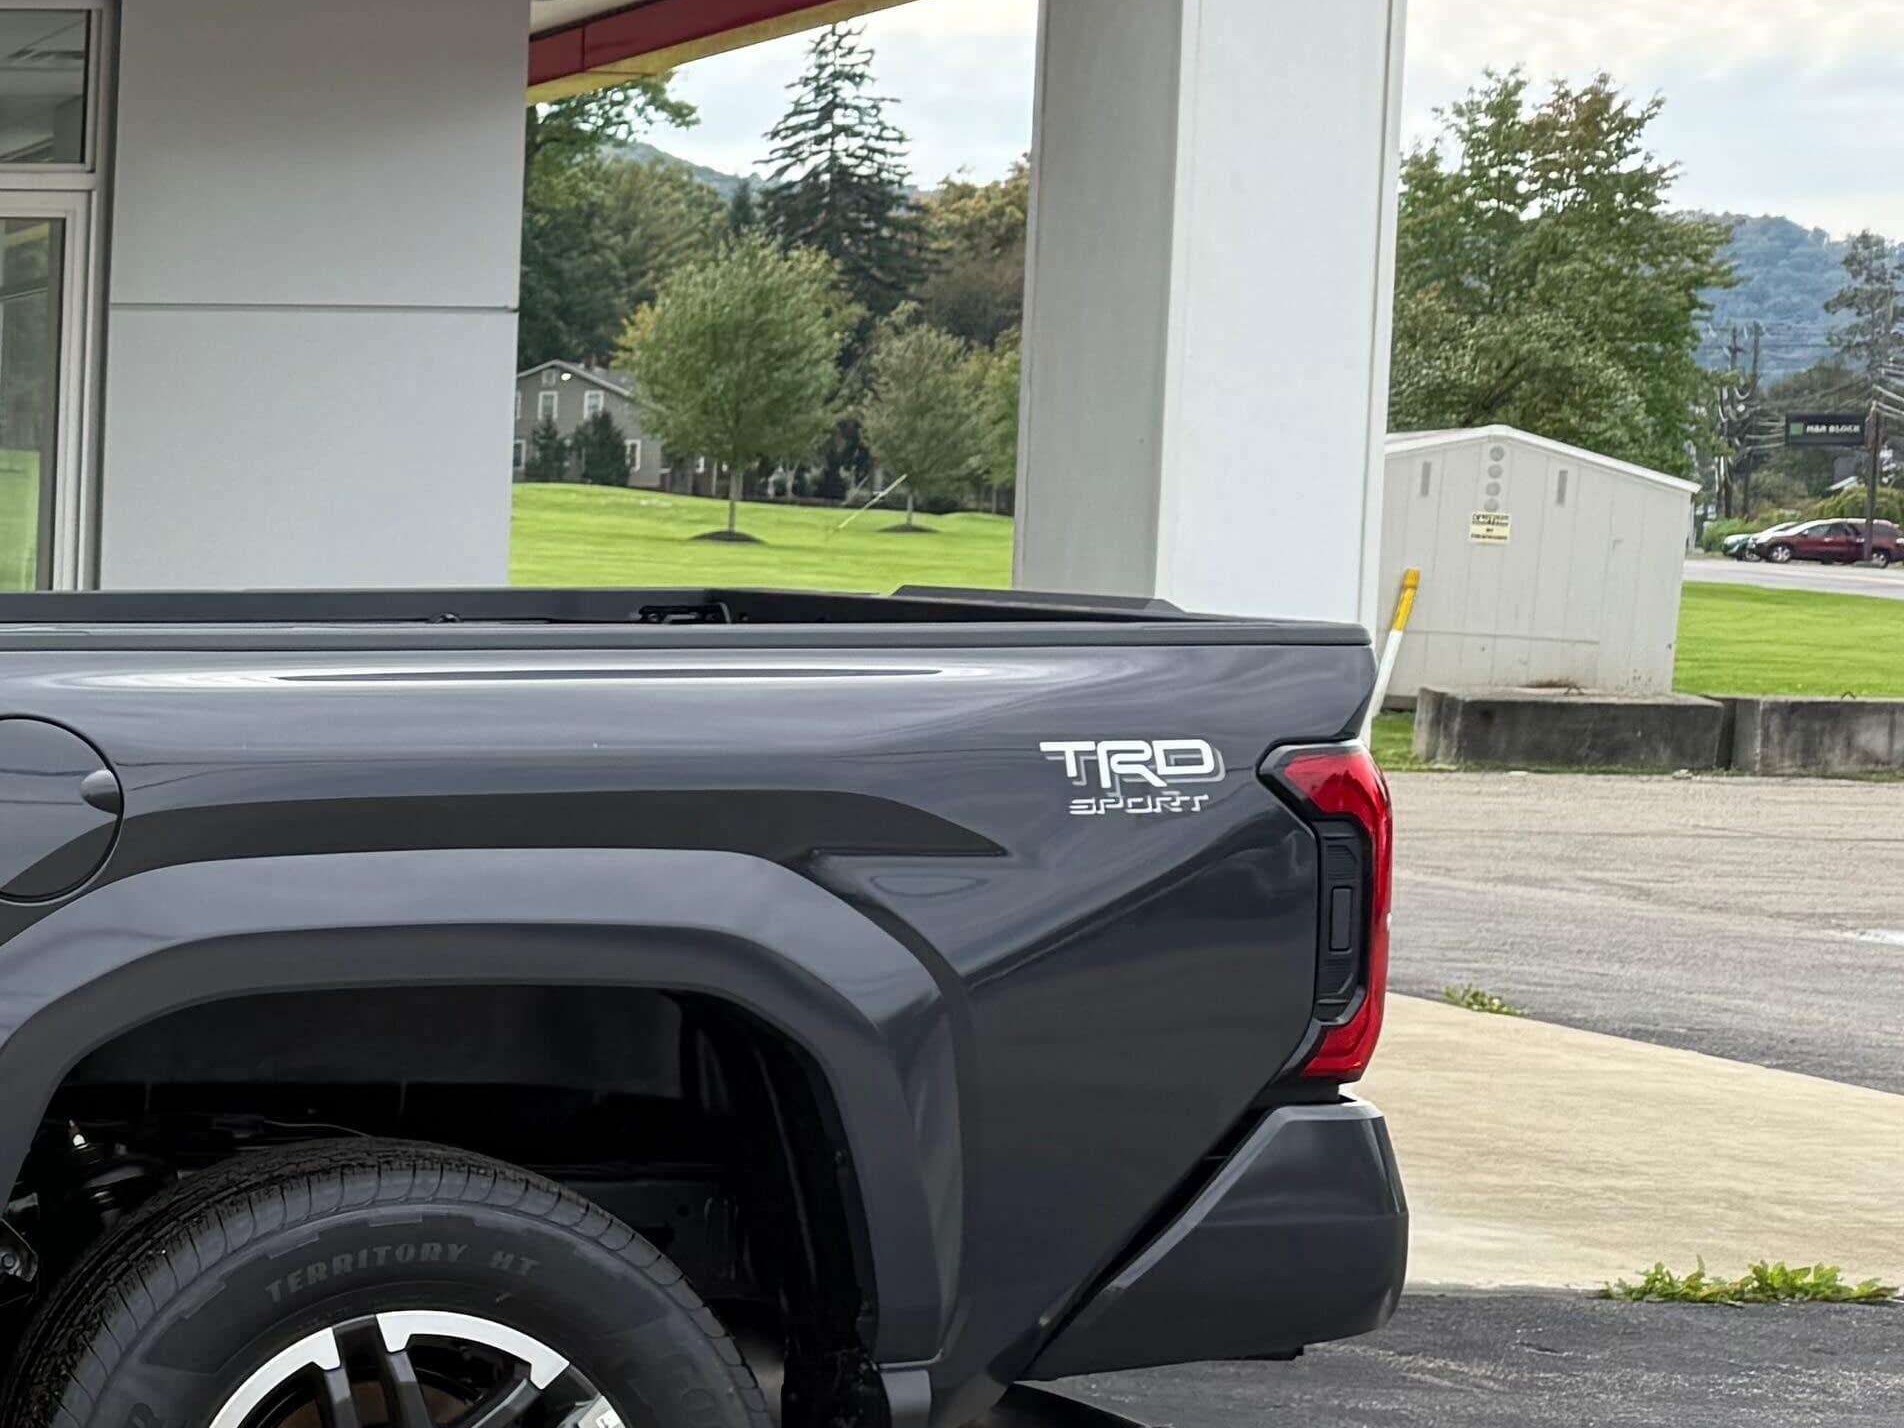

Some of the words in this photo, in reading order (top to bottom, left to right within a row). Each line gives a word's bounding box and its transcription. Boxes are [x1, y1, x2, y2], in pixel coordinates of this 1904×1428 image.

[1039, 738, 1218, 789] TRD
[1068, 794, 1209, 815] SPORT
[265, 1242, 469, 1303] TERRITORY
[492, 1250, 540, 1276] HT
